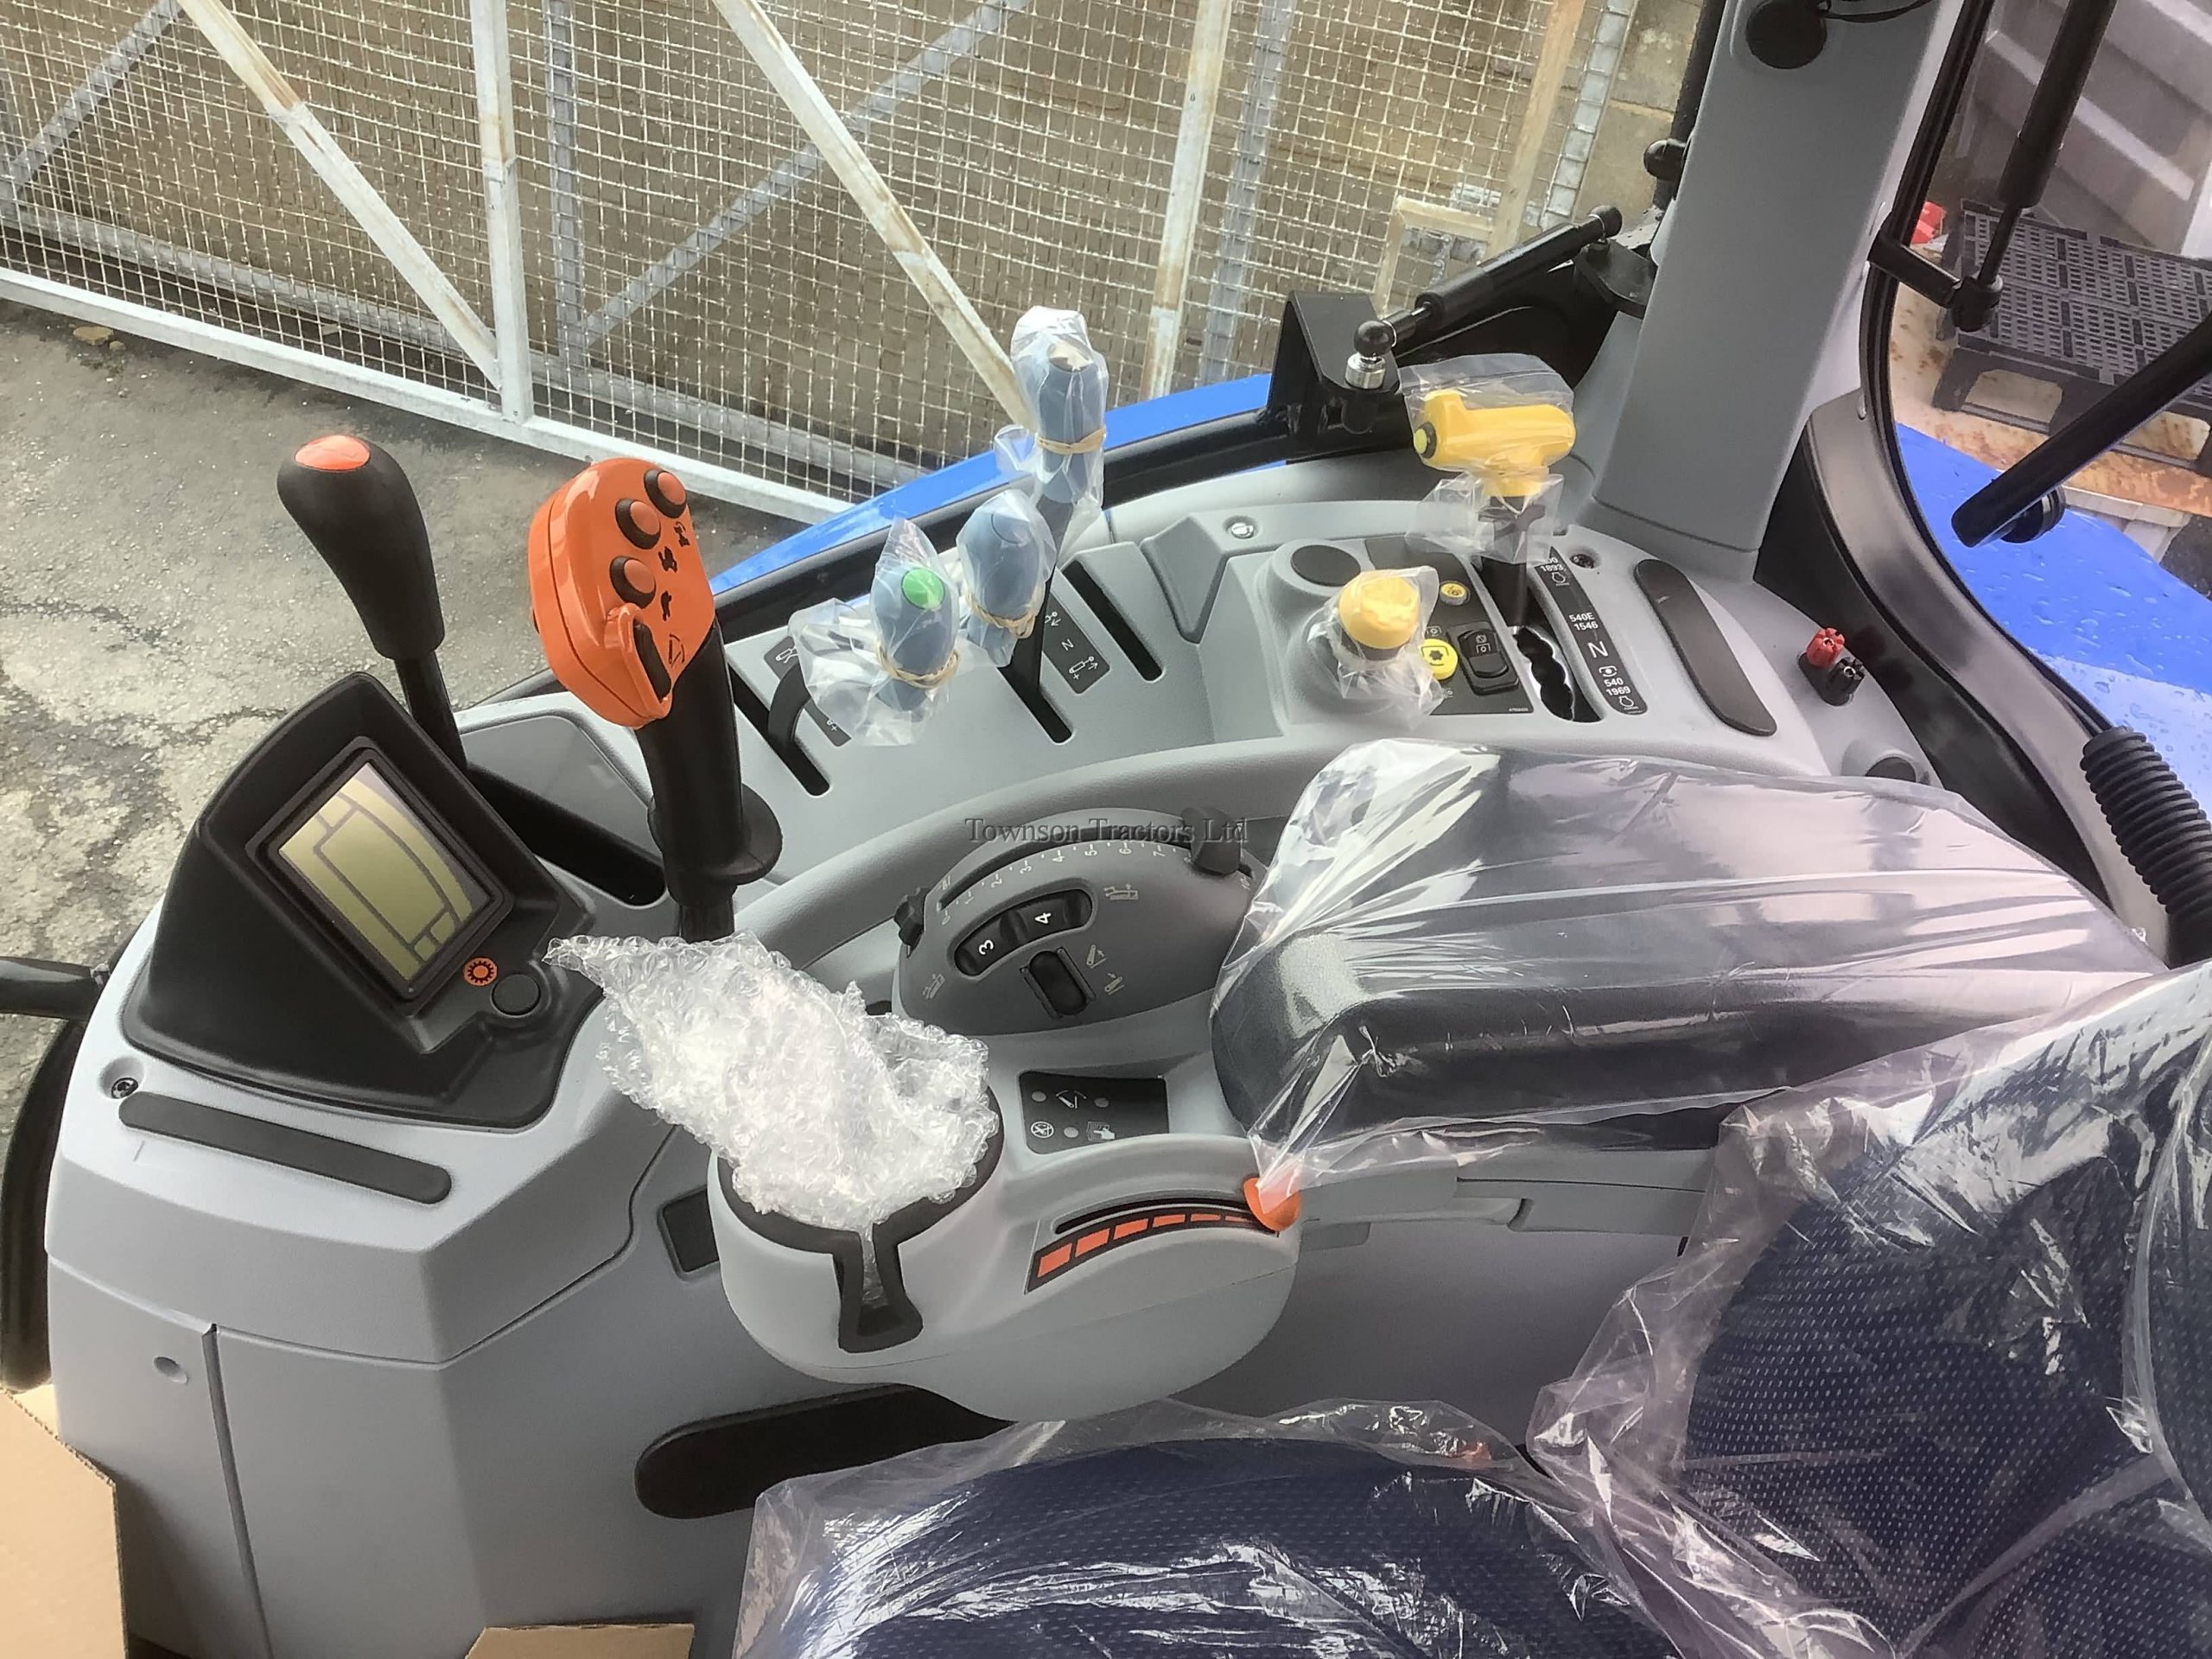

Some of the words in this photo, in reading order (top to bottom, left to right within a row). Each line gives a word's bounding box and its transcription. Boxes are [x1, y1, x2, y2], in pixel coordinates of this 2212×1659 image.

[1568, 612, 1595, 622] 540E
[1573, 621, 1599, 631] 1546
[1061, 639, 1074, 651] N
[1587, 640, 1609, 658] N
[1604, 677, 1624, 687] 540
[1606, 686, 1630, 696] 1969
[990, 878, 1003, 888] 2
[1020, 865, 1033, 874] 3
[1052, 855, 1065, 863] 4
[1118, 847, 1132, 855] 6
[1152, 849, 1166, 858] 7
[978, 939, 994, 955] 3
[1034, 912, 1052, 924] 4
